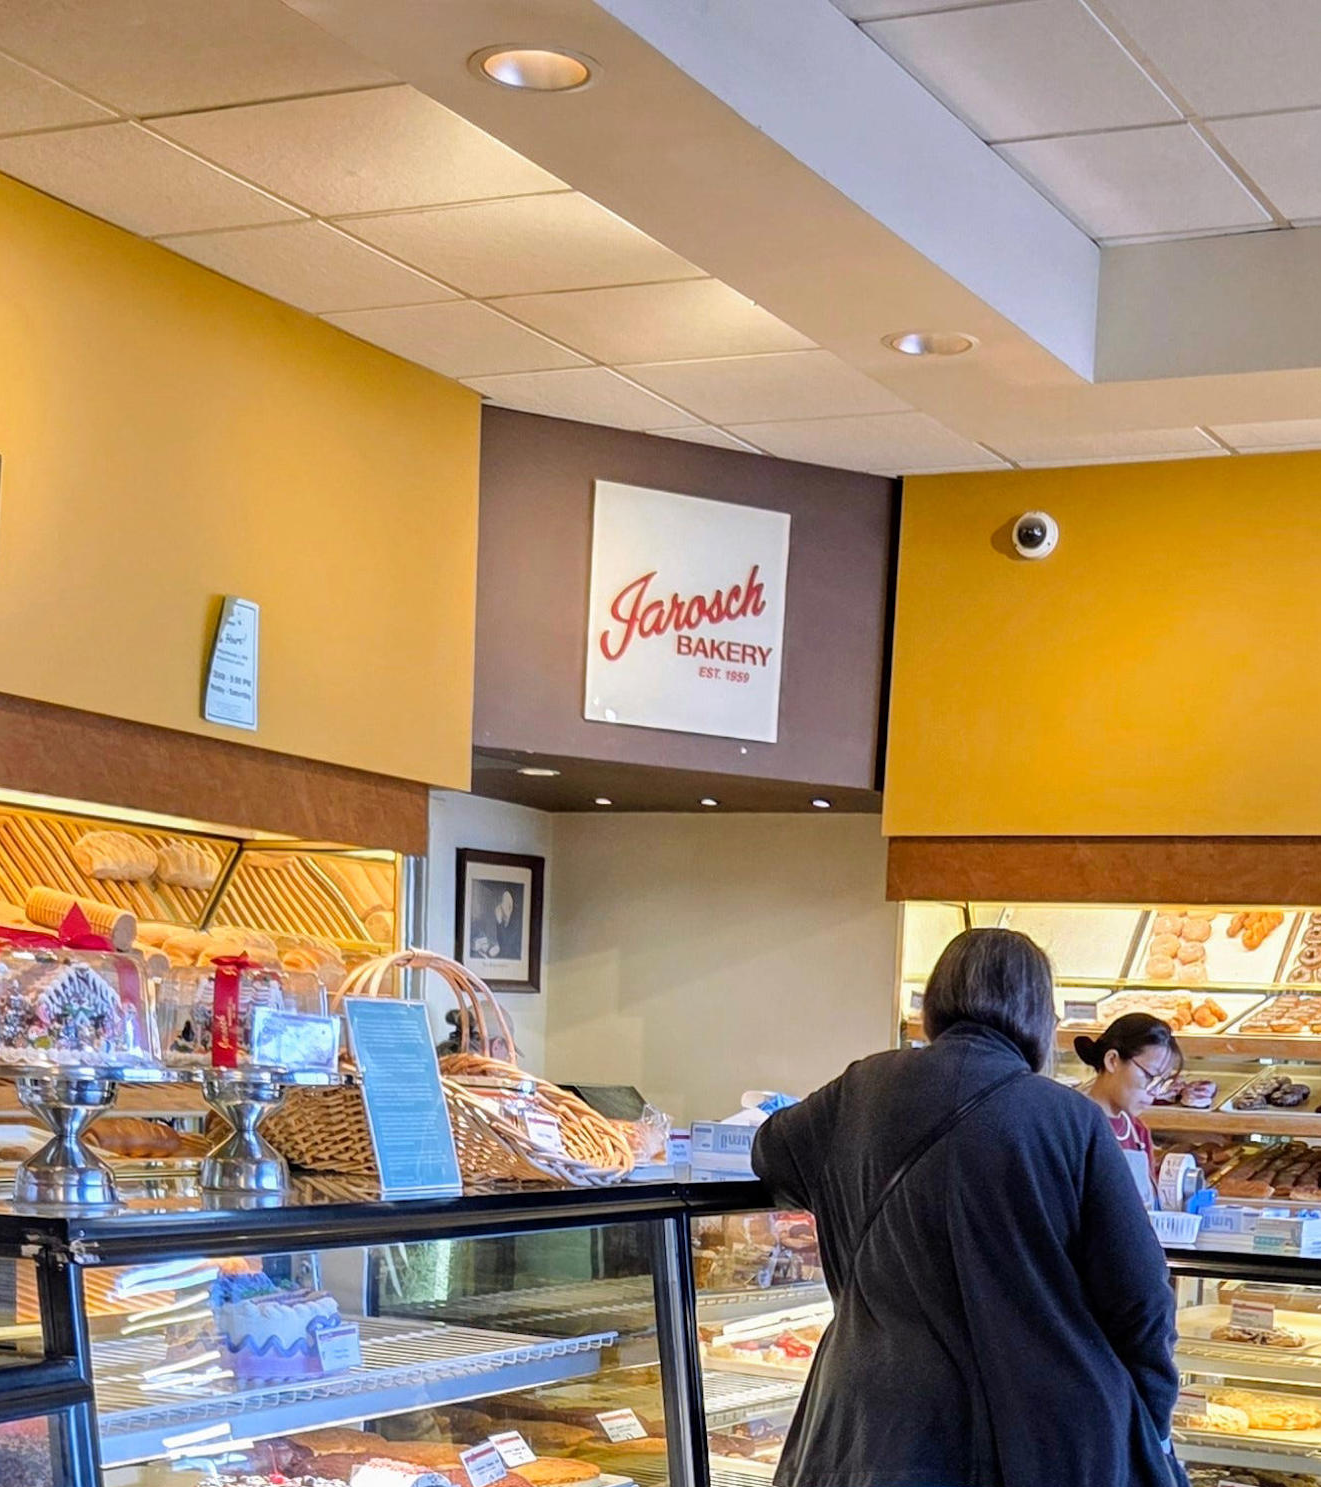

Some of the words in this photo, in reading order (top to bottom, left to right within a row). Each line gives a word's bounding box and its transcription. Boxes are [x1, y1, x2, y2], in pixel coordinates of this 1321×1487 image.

[599, 563, 766, 662] Jarosch
[676, 635, 773, 668] BAKERY
[698, 667, 722, 681] EST.
[724, 669, 750, 684] 1959
